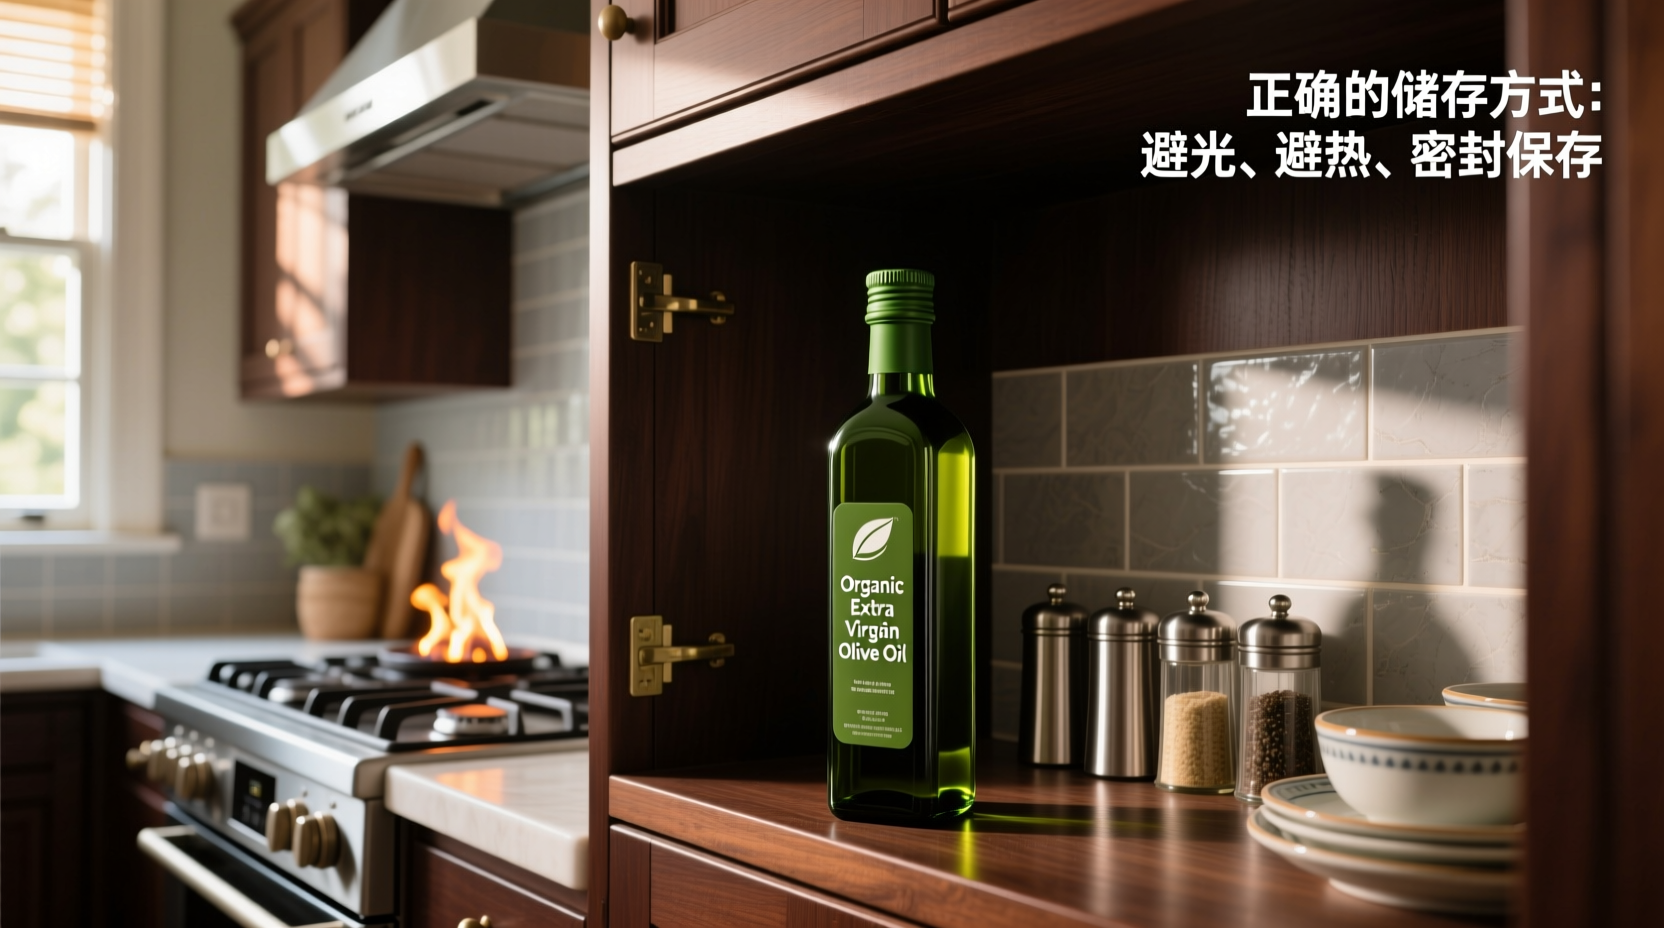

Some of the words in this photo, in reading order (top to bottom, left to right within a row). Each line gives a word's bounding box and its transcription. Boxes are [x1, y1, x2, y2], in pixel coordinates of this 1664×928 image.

[840, 575, 905, 597] Organic
[850, 598, 894, 617] Extra
[838, 642, 880, 661] Olive
[883, 643, 907, 663] Oil
